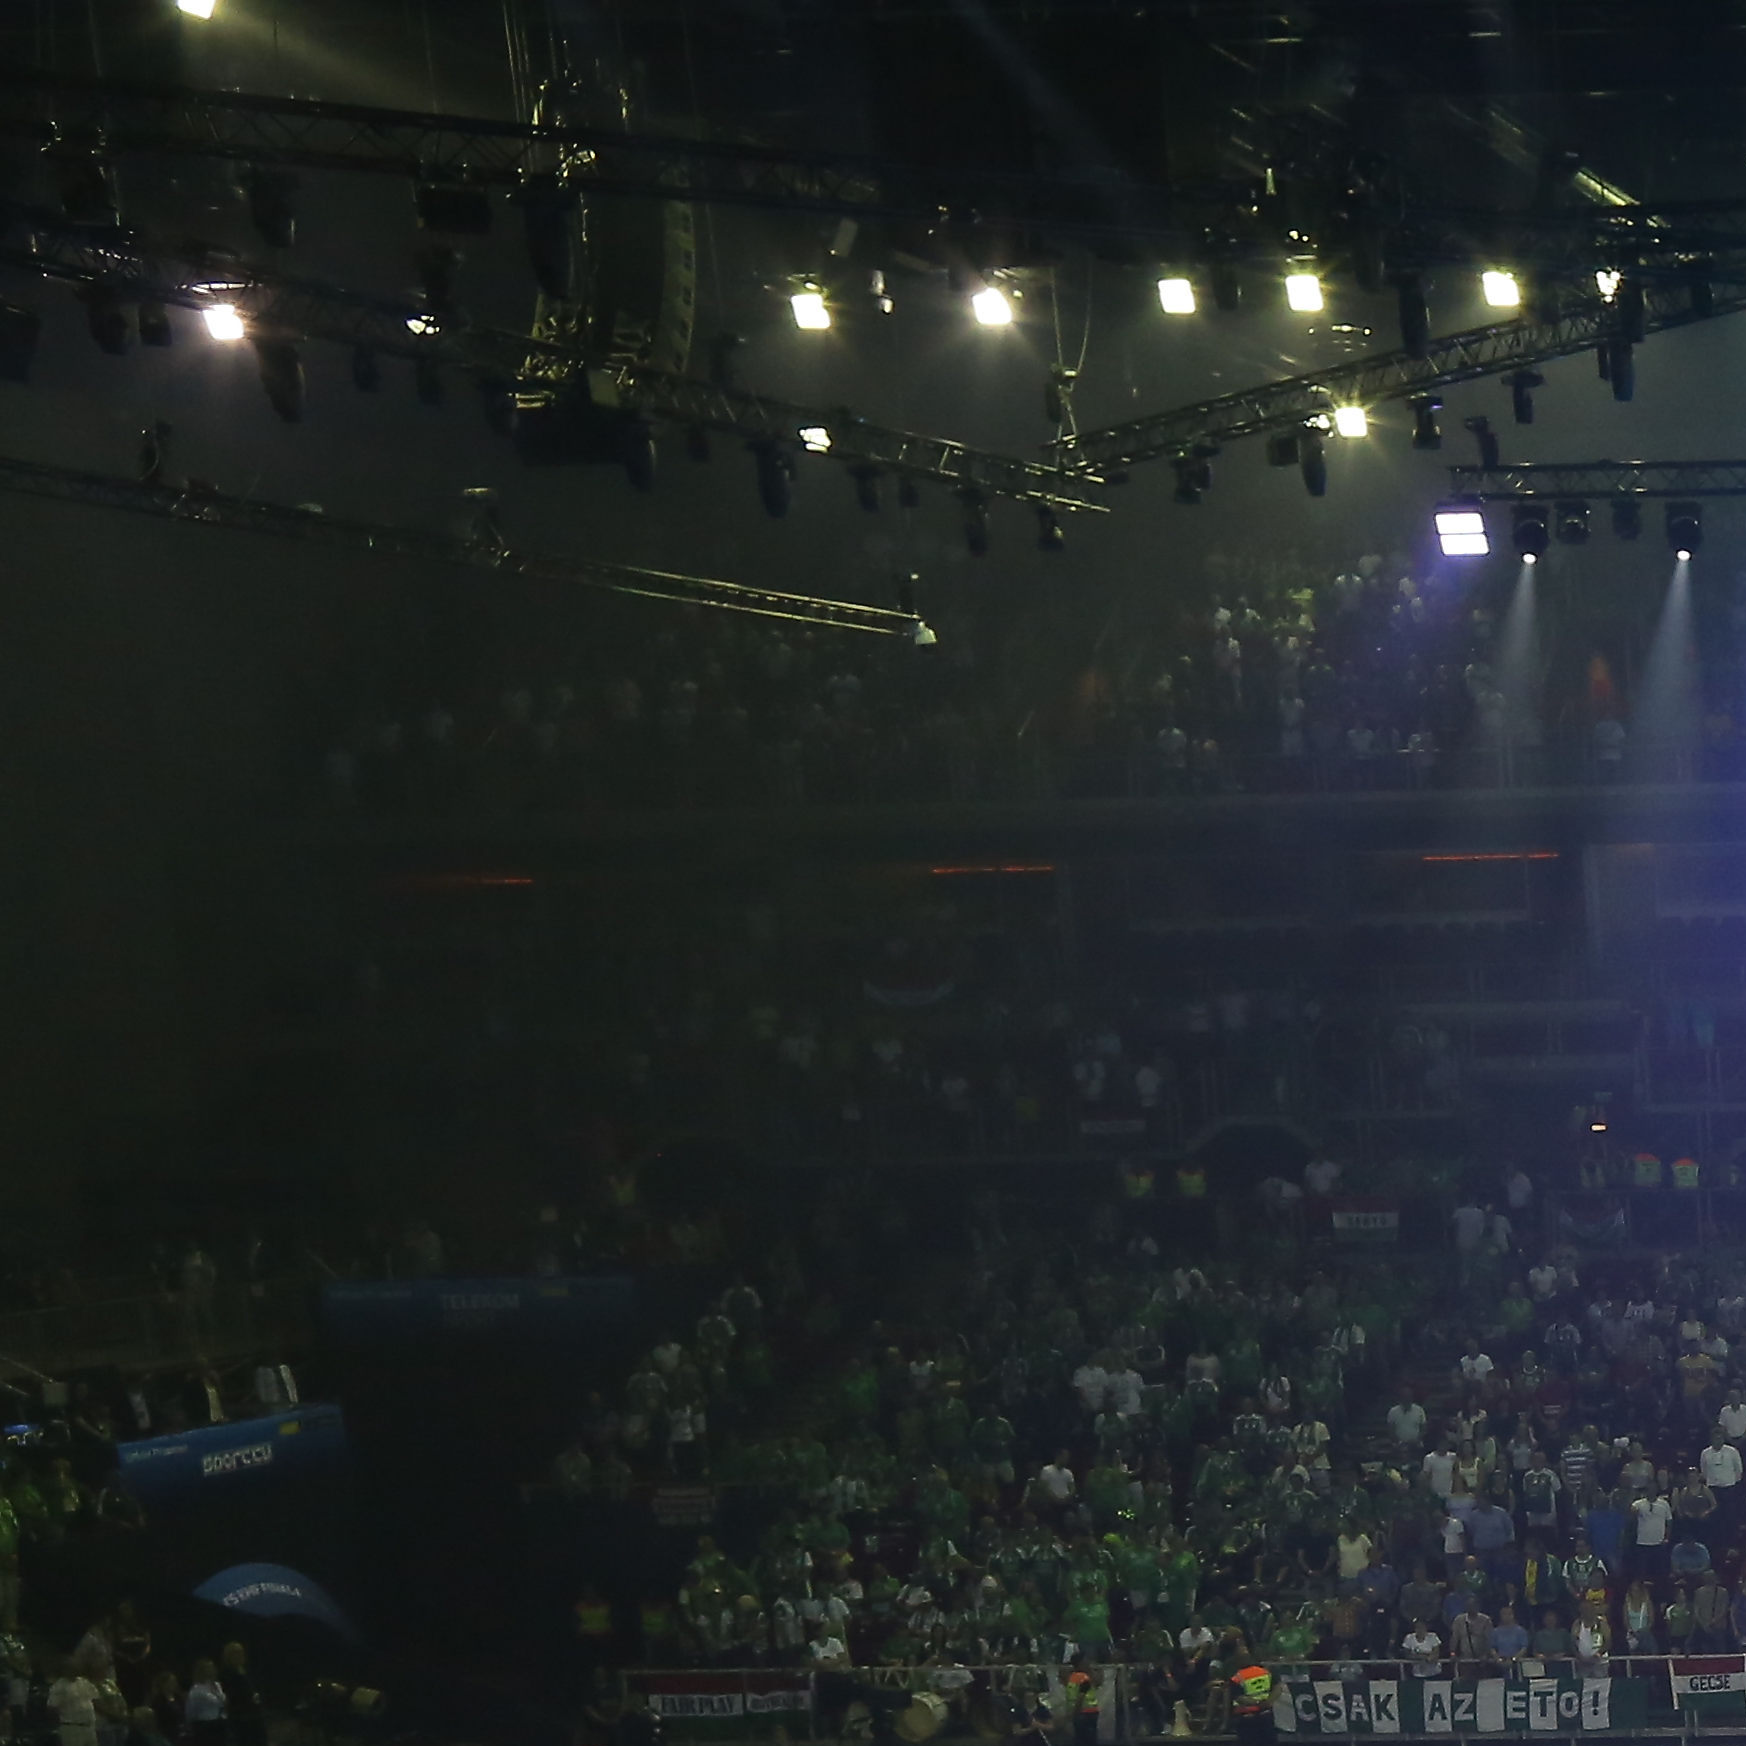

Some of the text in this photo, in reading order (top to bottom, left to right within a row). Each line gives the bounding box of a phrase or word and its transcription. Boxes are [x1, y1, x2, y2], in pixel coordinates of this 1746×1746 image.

[1689, 1673, 1731, 1691] GECSE
[1295, 1683, 1602, 1723] CSAK AZ ETO!
